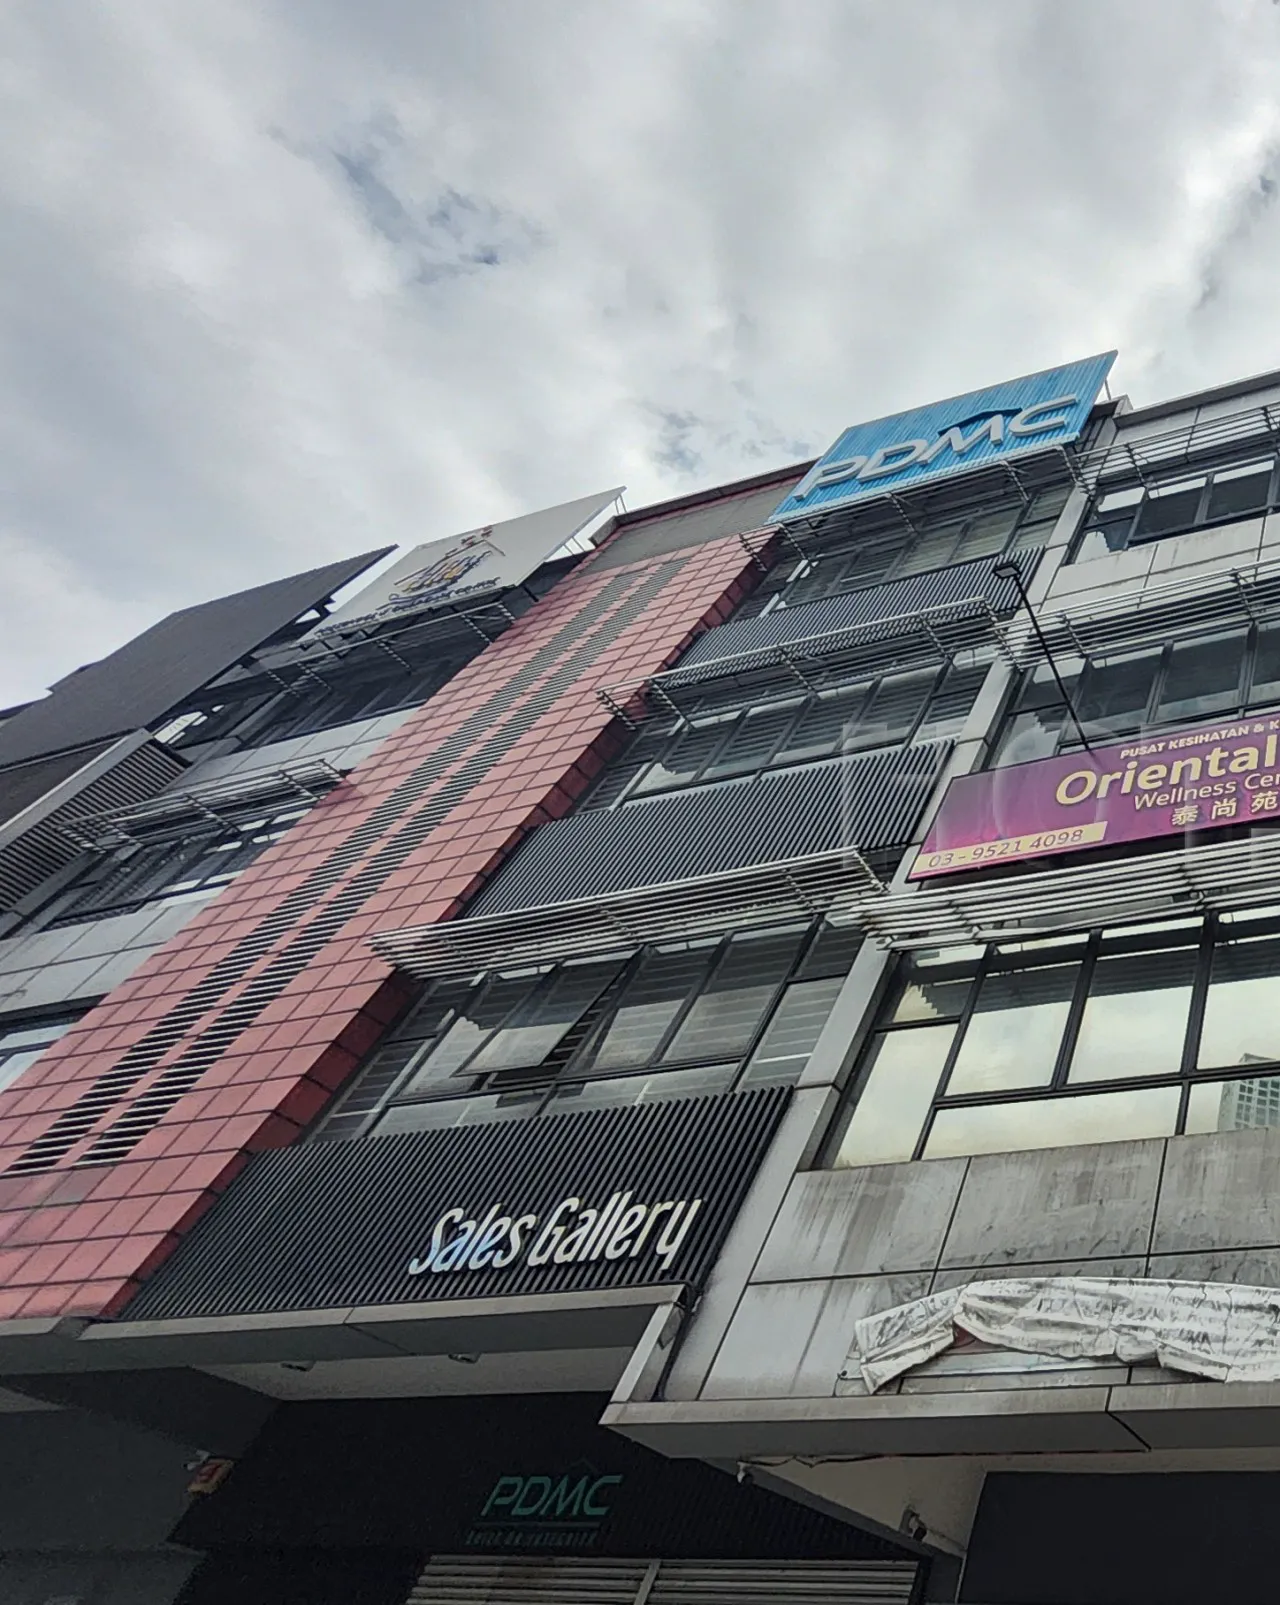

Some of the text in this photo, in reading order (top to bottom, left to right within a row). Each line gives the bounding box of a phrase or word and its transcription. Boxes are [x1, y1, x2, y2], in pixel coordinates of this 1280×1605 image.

[793, 394, 1077, 500] PDMC
[1120, 742, 1165, 759] PUSAT
[1168, 725, 1249, 750] KESIHATAN
[1253, 723, 1264, 733] &
[1056, 734, 1278, 806] Oriental
[1134, 780, 1237, 810] Wellness
[928, 854, 955, 868] 03
[973, 840, 1021, 862] 9521
[1029, 829, 1084, 850] 4098
[409, 1190, 702, 1275] Sales Gallery
[480, 1474, 624, 1516] PDMC
